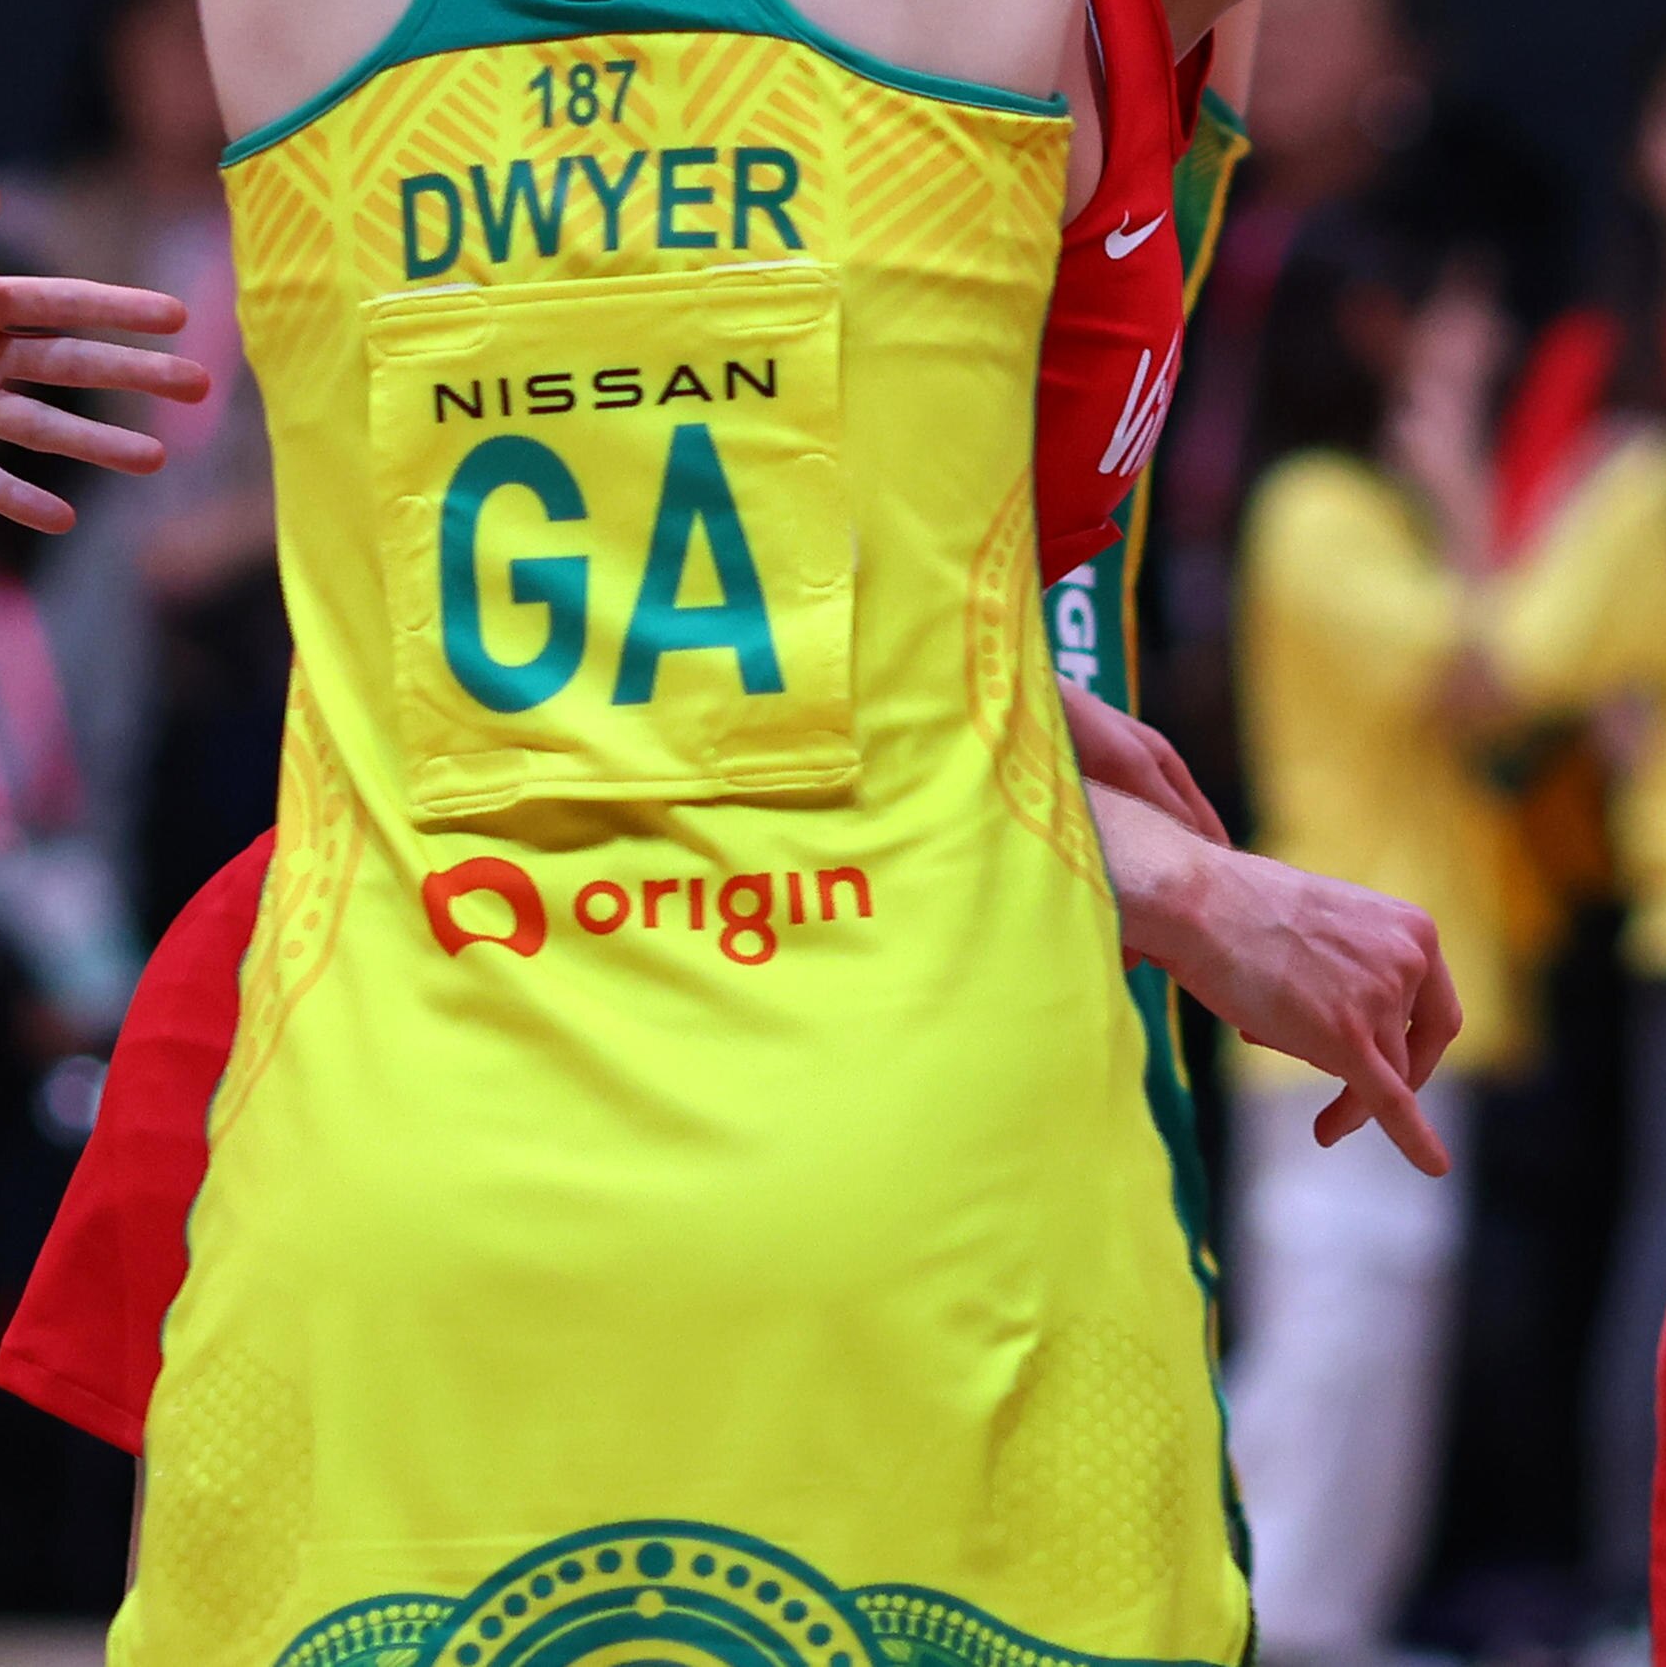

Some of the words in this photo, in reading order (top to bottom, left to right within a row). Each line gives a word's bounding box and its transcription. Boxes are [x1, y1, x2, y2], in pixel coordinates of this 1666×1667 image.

[527, 60, 637, 128] 187
[400, 146, 806, 280] DWYER
[434, 358, 778, 423] NISSAN
[438, 422, 785, 713] GA
[573, 865, 872, 966] origin
